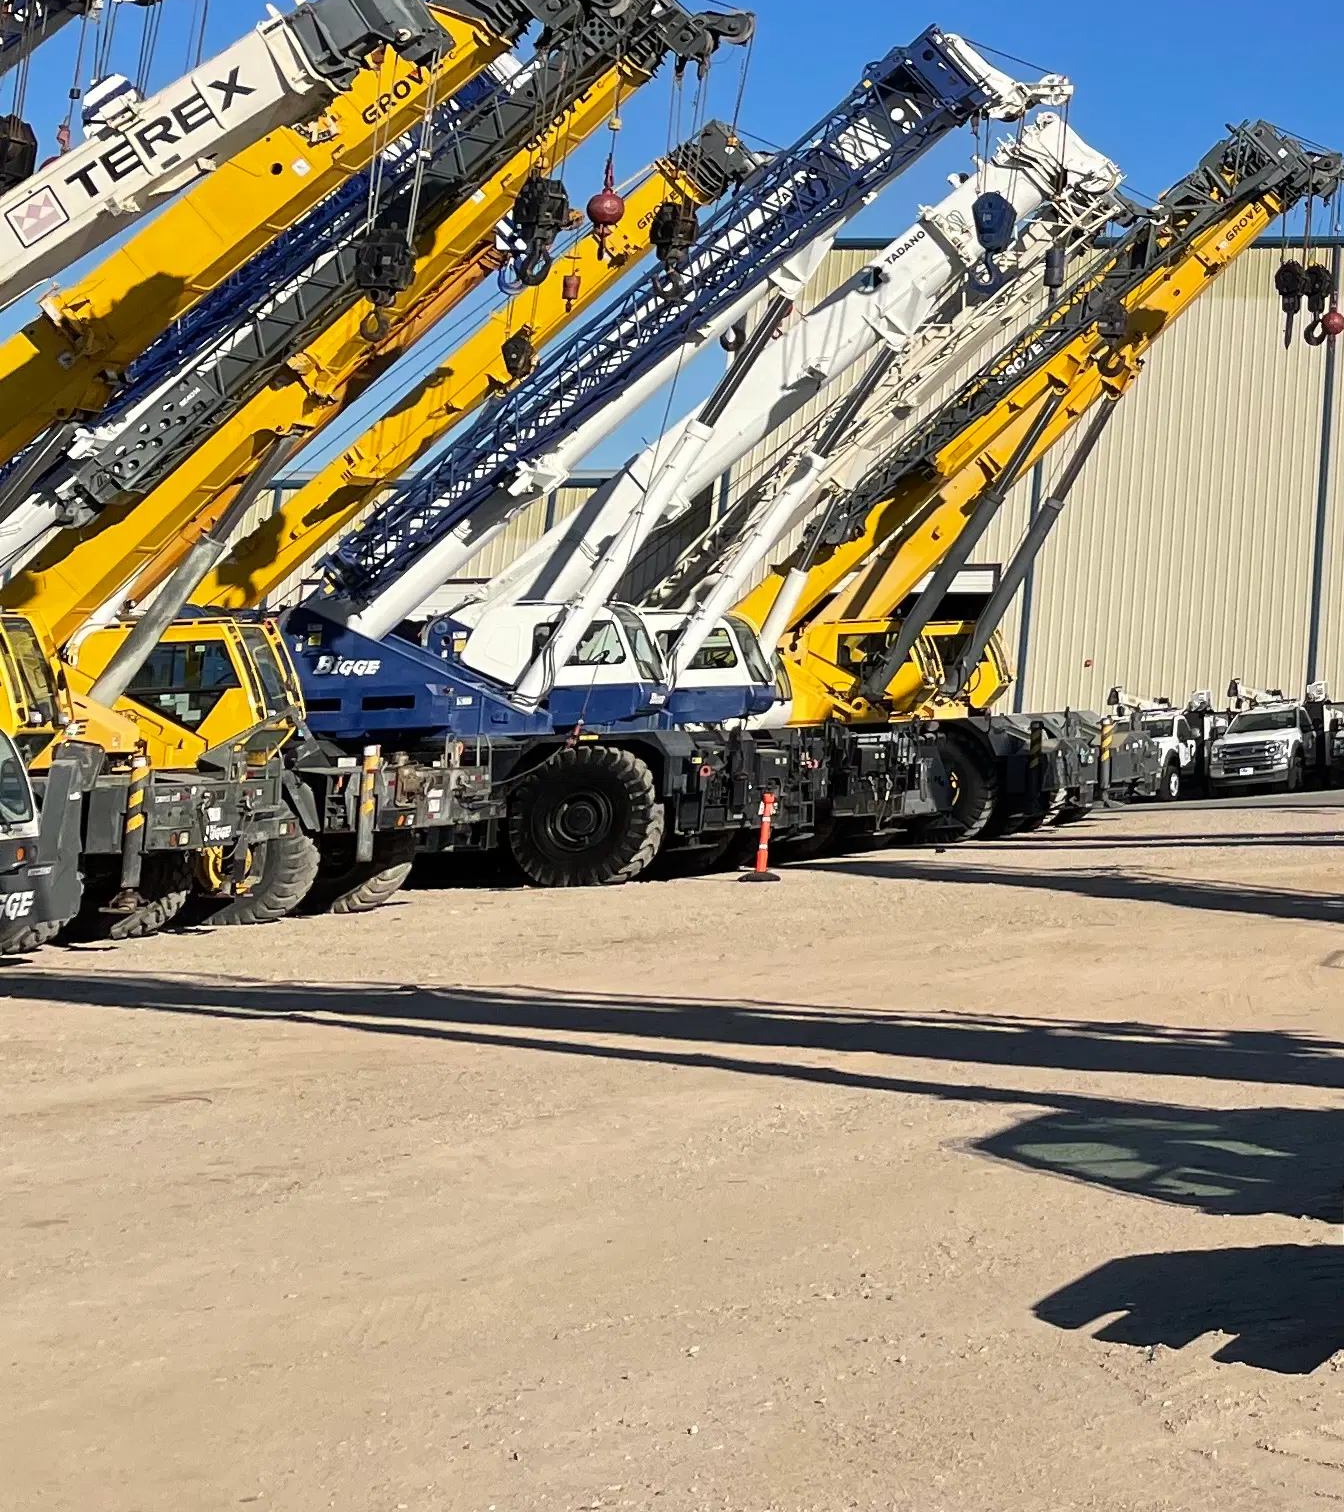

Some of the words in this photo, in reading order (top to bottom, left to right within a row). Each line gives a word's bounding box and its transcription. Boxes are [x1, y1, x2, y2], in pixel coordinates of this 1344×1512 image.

[362, 61, 446, 125] GROV
[64, 65, 257, 198] TEREX
[637, 190, 680, 230] GROE
[1225, 201, 1263, 242] GROVE
[884, 230, 926, 265] TADANO
